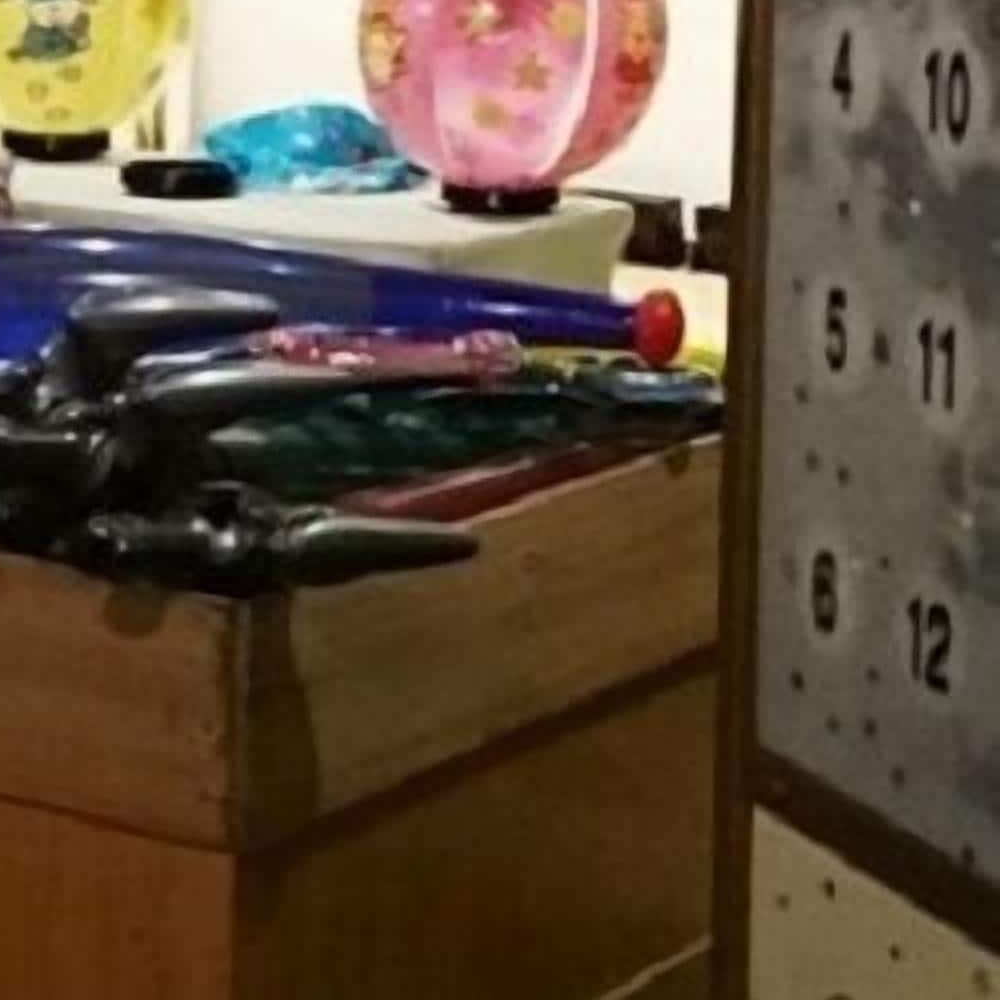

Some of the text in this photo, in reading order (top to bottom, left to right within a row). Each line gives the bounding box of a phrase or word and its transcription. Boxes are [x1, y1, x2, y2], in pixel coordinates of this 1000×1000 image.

[832, 29, 853, 111] 4
[925, 50, 971, 143] 10
[825, 287, 847, 372] 5
[918, 317, 955, 411] 11
[812, 549, 838, 634] 6
[907, 597, 951, 695] 12
